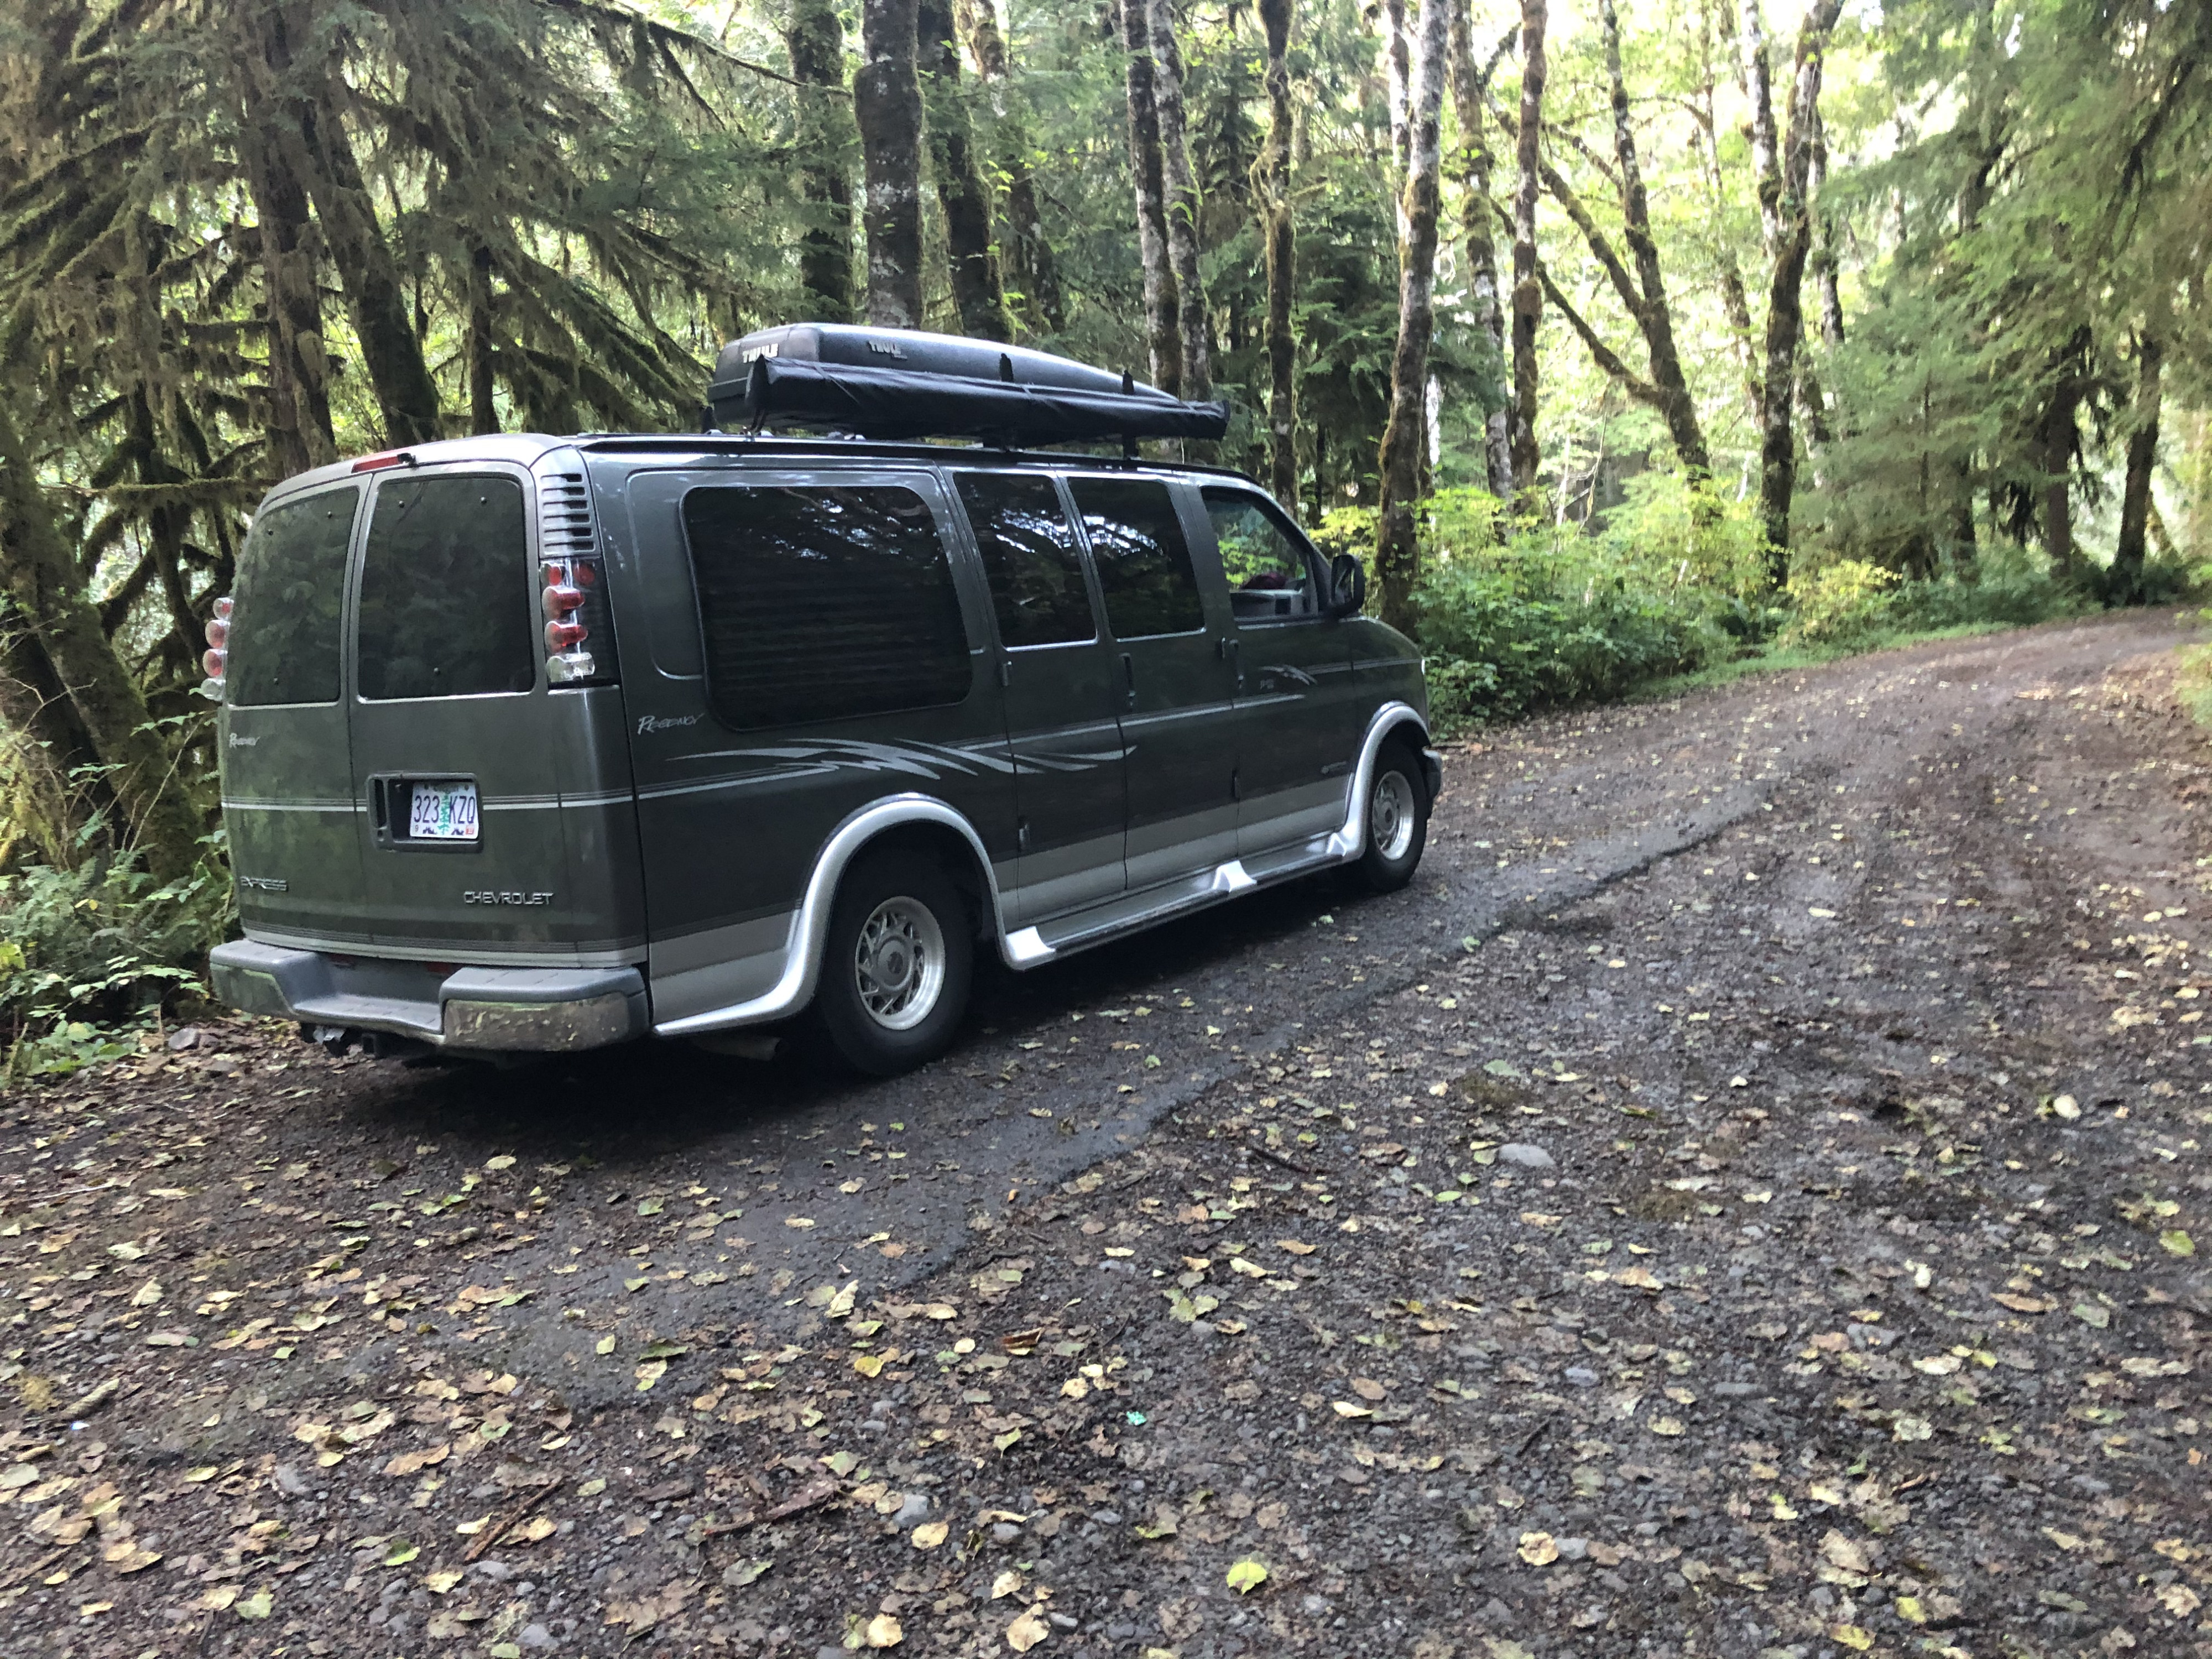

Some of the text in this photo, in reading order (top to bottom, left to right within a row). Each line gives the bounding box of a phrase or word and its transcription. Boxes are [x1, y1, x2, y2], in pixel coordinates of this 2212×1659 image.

[414, 795, 476, 824] 323 KZQ
[463, 890, 554, 905] CHEVROLET
